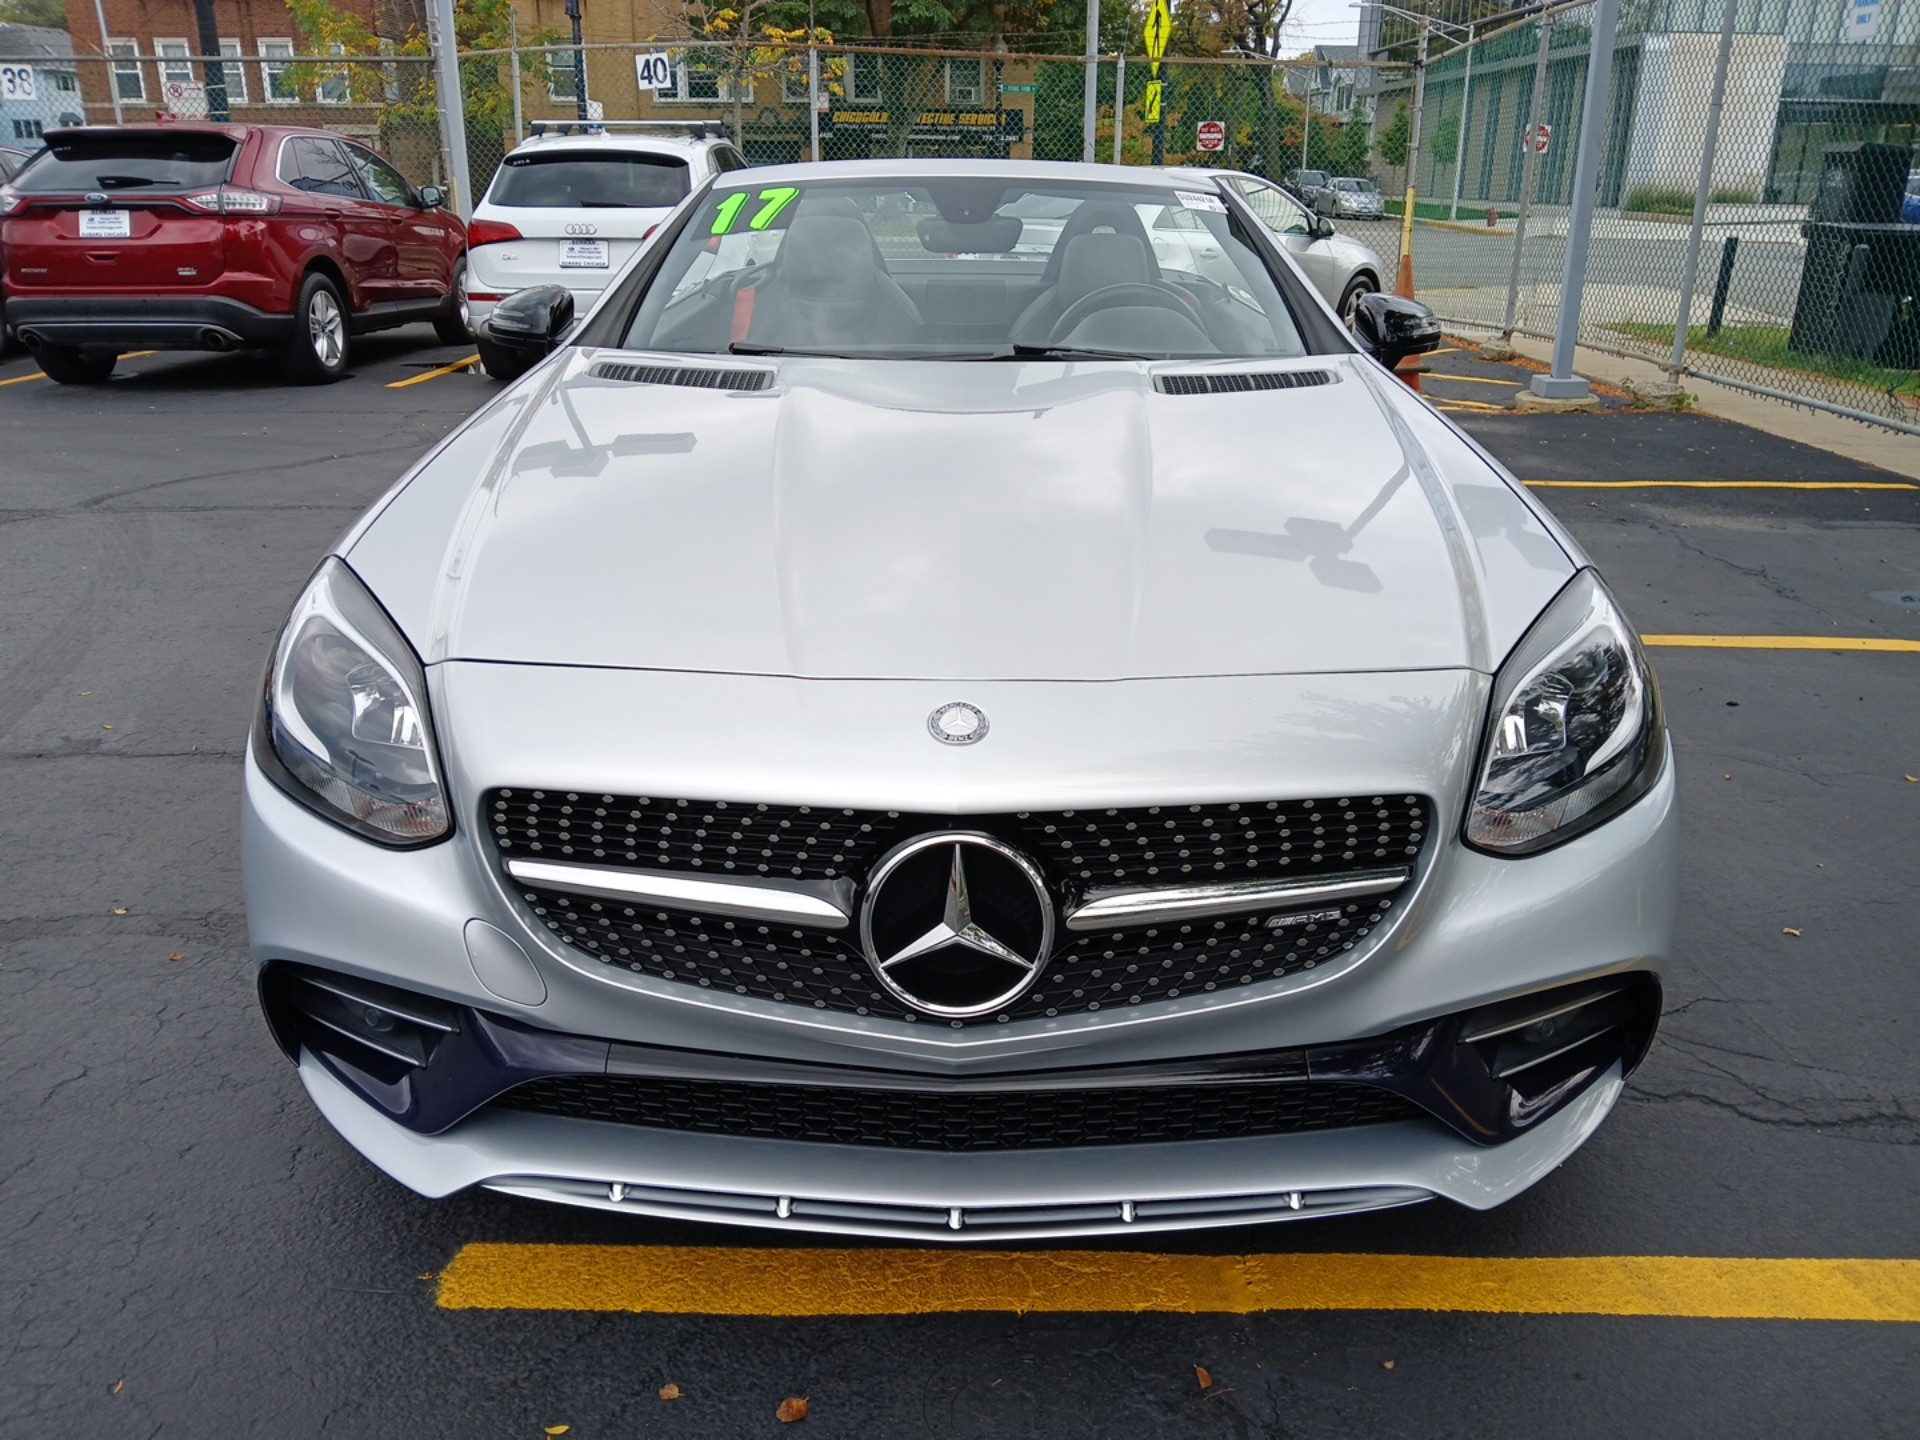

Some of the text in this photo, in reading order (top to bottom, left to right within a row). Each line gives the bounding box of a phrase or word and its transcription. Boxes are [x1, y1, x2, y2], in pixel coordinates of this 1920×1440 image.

[2, 67, 33, 96] 38
[640, 56, 668, 85] 40
[711, 187, 800, 235] 17
